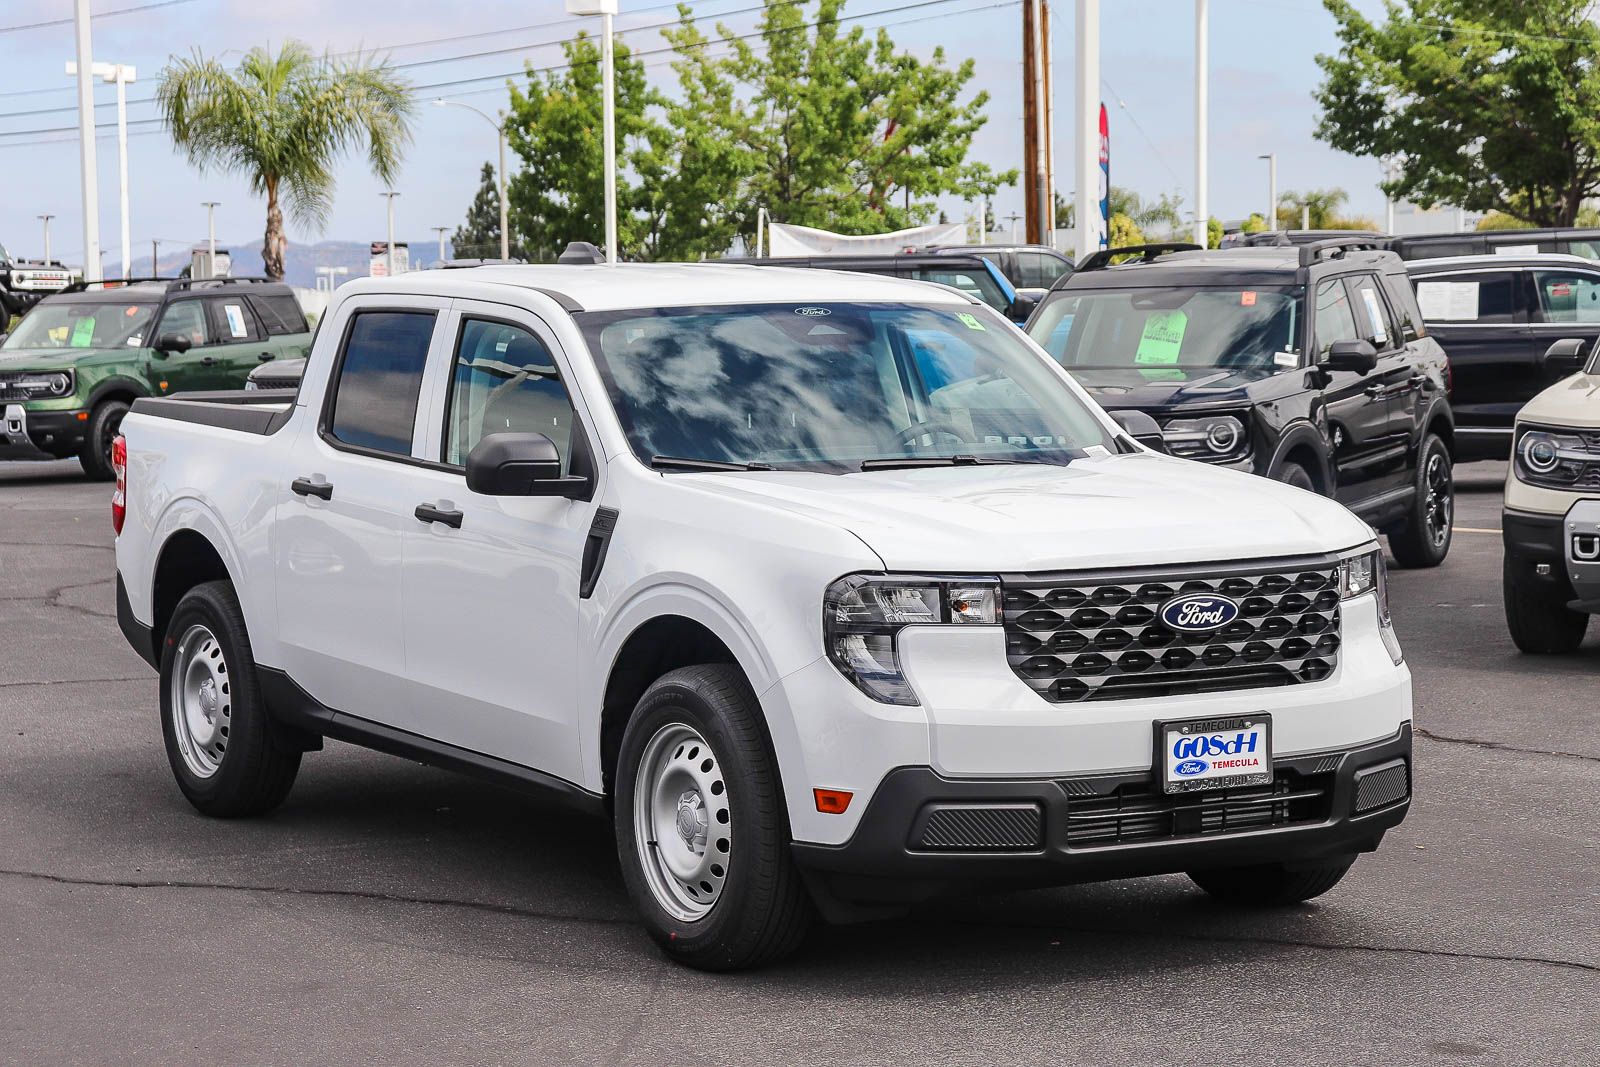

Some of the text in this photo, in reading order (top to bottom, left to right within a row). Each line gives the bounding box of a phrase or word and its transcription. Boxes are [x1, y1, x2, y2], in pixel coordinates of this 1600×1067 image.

[1177, 601, 1225, 625] Ford
[1189, 719, 1245, 732] TEMECULA
[1180, 758, 1259, 774] Ford TEMECULA
